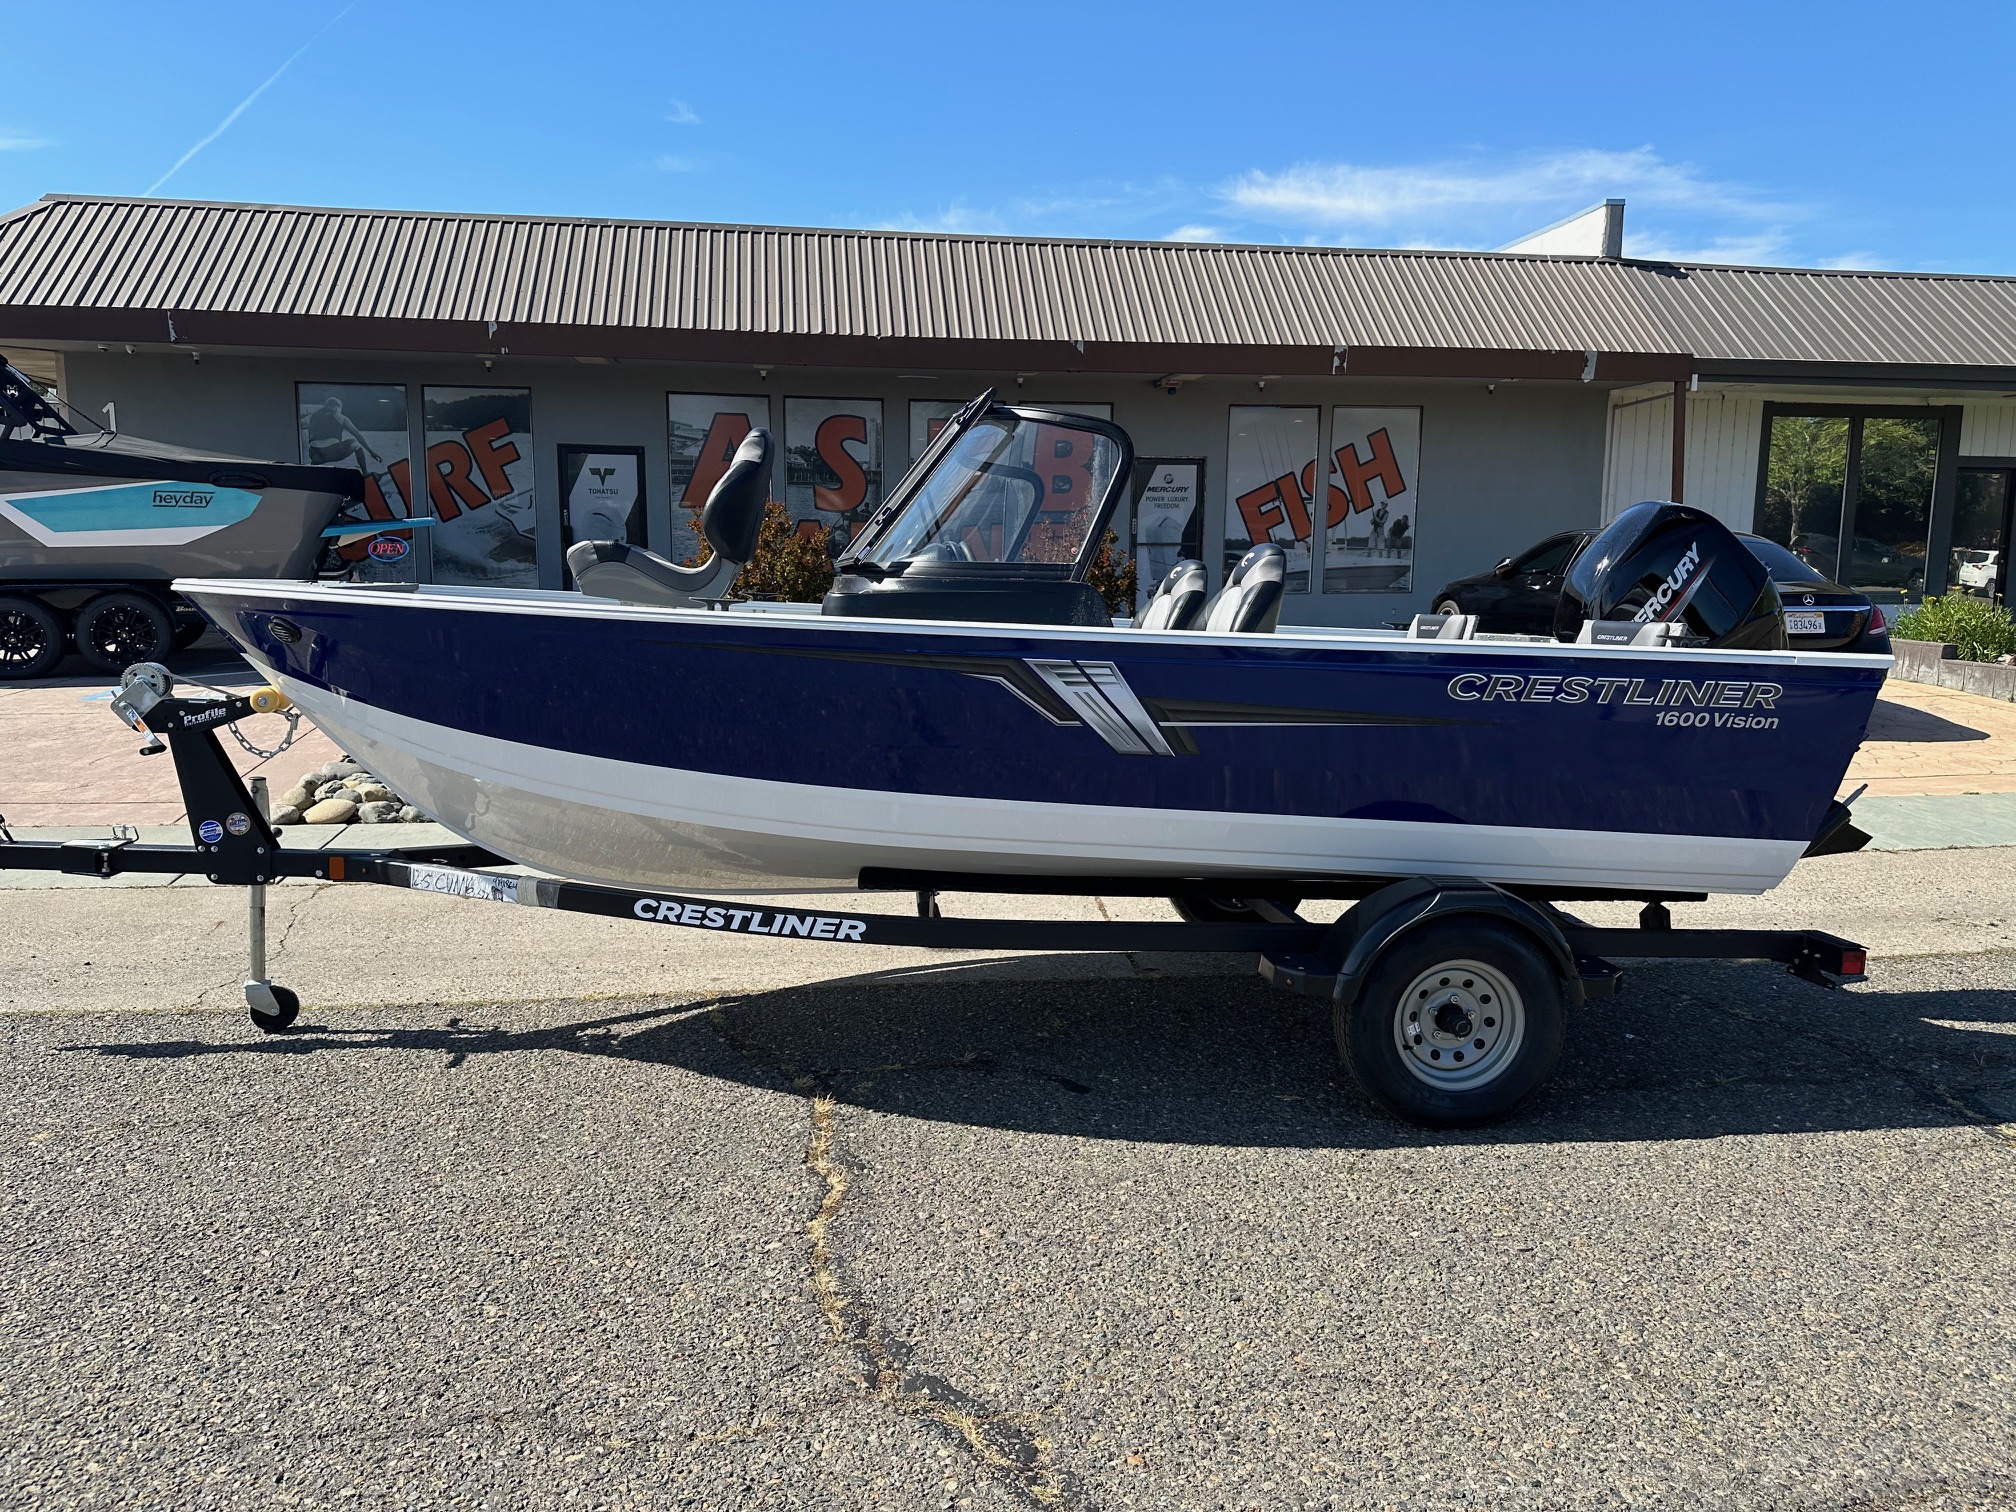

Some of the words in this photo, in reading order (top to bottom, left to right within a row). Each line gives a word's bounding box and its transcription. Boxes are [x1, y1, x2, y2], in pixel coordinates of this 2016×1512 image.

[1236, 427, 1407, 546] FISH
[152, 490, 214, 508] heyday
[370, 543, 406, 555] OPEN
[1631, 541, 1700, 622] ERCURY
[1793, 620, 1818, 630] 83496
[1447, 673, 1783, 709] CRESTLINER
[183, 707, 227, 724] Profile
[1655, 711, 1714, 728] 1600
[1715, 713, 1779, 730] Vision
[633, 898, 867, 941] CRESTLINER
